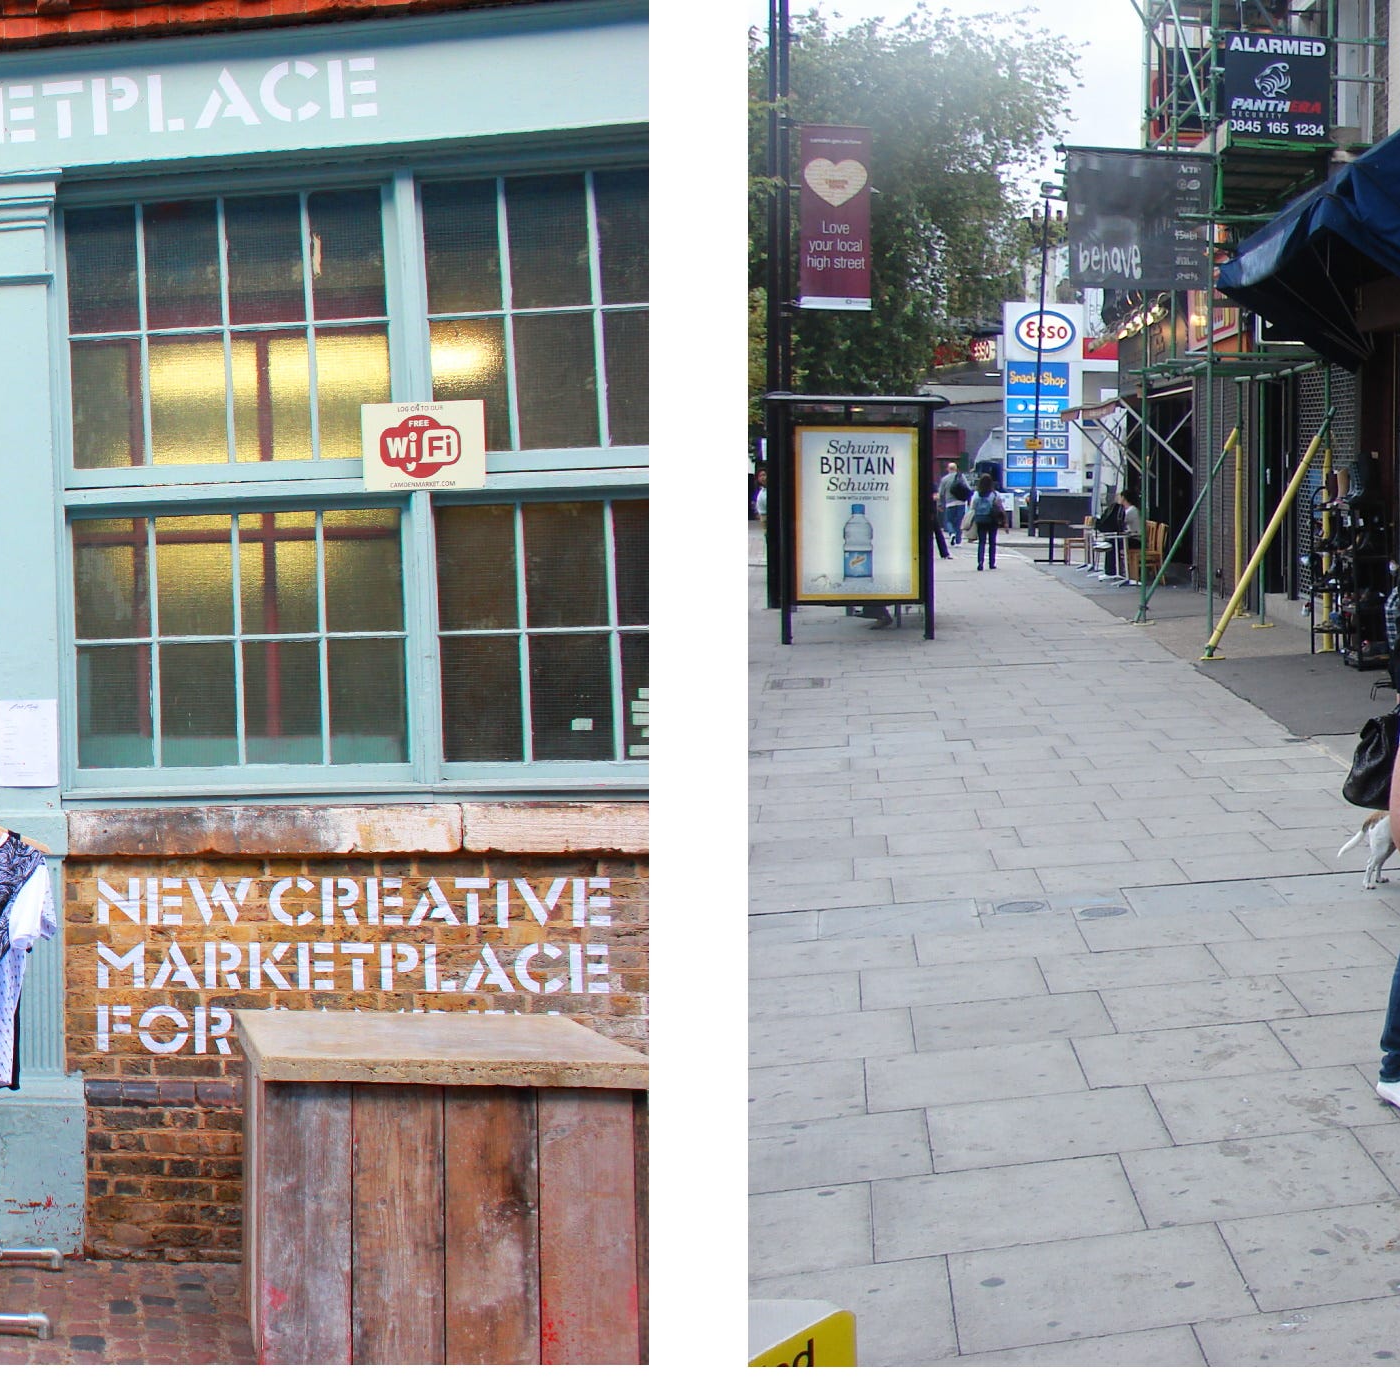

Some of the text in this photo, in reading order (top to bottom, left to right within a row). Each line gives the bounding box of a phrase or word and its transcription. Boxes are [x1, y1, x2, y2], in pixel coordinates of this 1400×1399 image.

[1229, 36, 1327, 57] ALARMED
[1231, 97, 1321, 114] PANTHERA
[1231, 110, 1282, 119] SECURITY
[1267, 121, 1290, 135] 165
[1294, 123, 1326, 137] 1234
[822, 220, 850, 234] Love
[809, 239, 863, 253] your local
[807, 255, 866, 271] high street
[1078, 242, 1143, 280] behave
[408, 420, 430, 428] FREE
[827, 439, 890, 455] Schwim
[820, 456, 895, 475] BRITAIN
[827, 476, 890, 492] Schwim
[97, 876, 612, 928] NEW CREATIVE
[97, 941, 610, 994] MARKETPLACE
[97, 1004, 234, 1055] FOR
